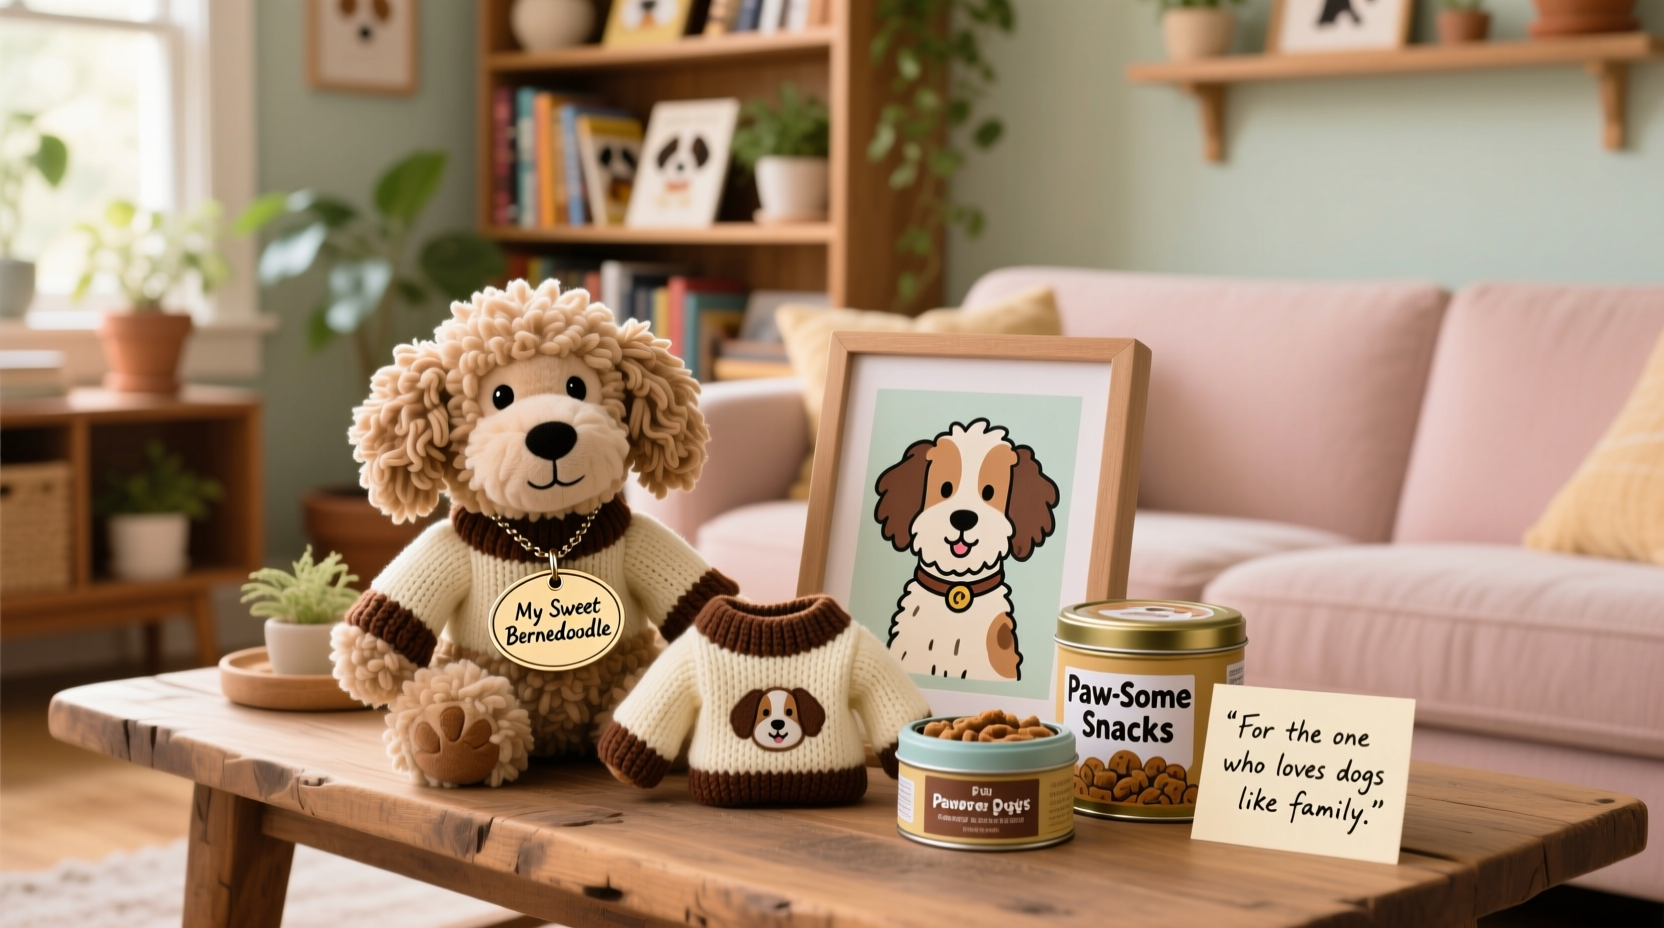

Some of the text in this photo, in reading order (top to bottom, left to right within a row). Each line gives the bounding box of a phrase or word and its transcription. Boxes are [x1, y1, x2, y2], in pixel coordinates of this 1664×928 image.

[515, 596, 601, 627] My Sweet
[505, 617, 612, 646] Bernedoodle
[1068, 673, 1192, 709] Paw-Some
[1082, 709, 1174, 744] Snacks
[1227, 710, 1370, 748] “For the one
[1223, 750, 1385, 796] who loves dogs
[1238, 785, 1384, 835] like family.”
